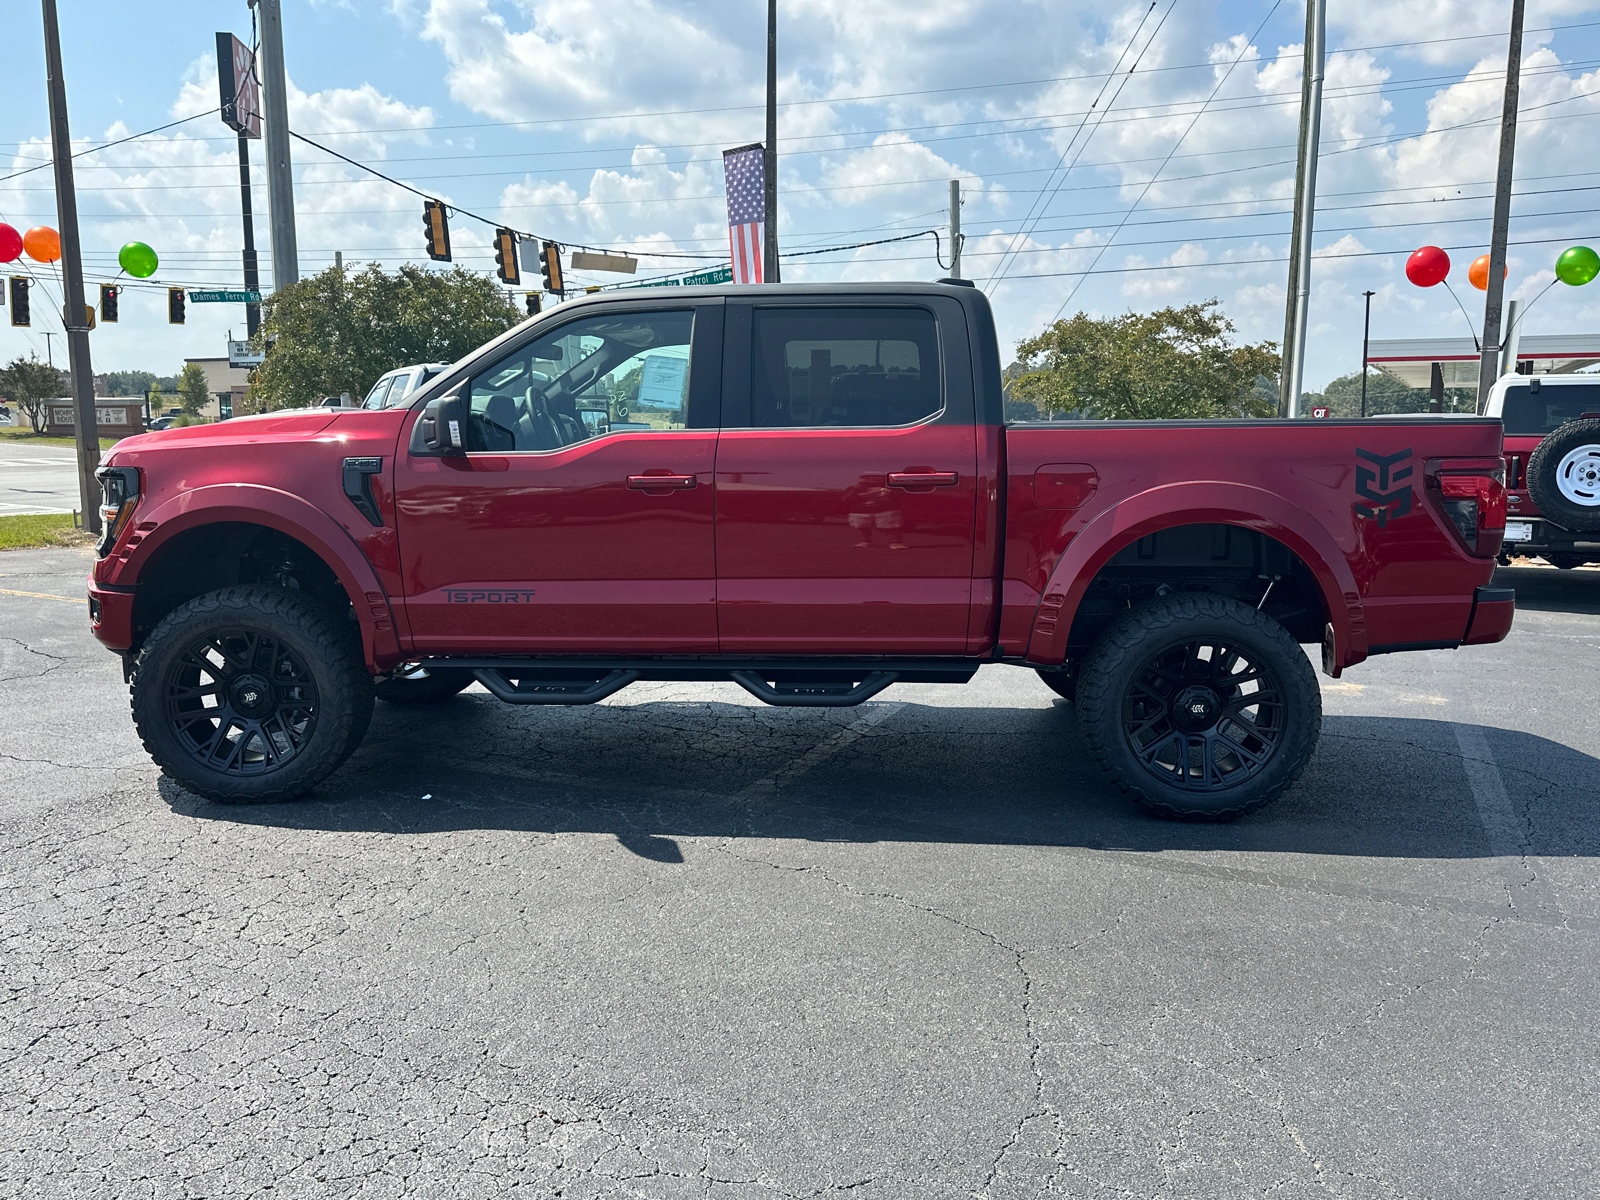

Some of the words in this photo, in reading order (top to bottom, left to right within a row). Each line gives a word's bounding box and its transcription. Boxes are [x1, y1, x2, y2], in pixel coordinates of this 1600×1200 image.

[686, 275, 709, 285] Patrol
[713, 272, 724, 281] Rd
[225, 292, 245, 302] Ferry
[250, 292, 260, 300] Rd
[1314, 409, 1326, 418] QT
